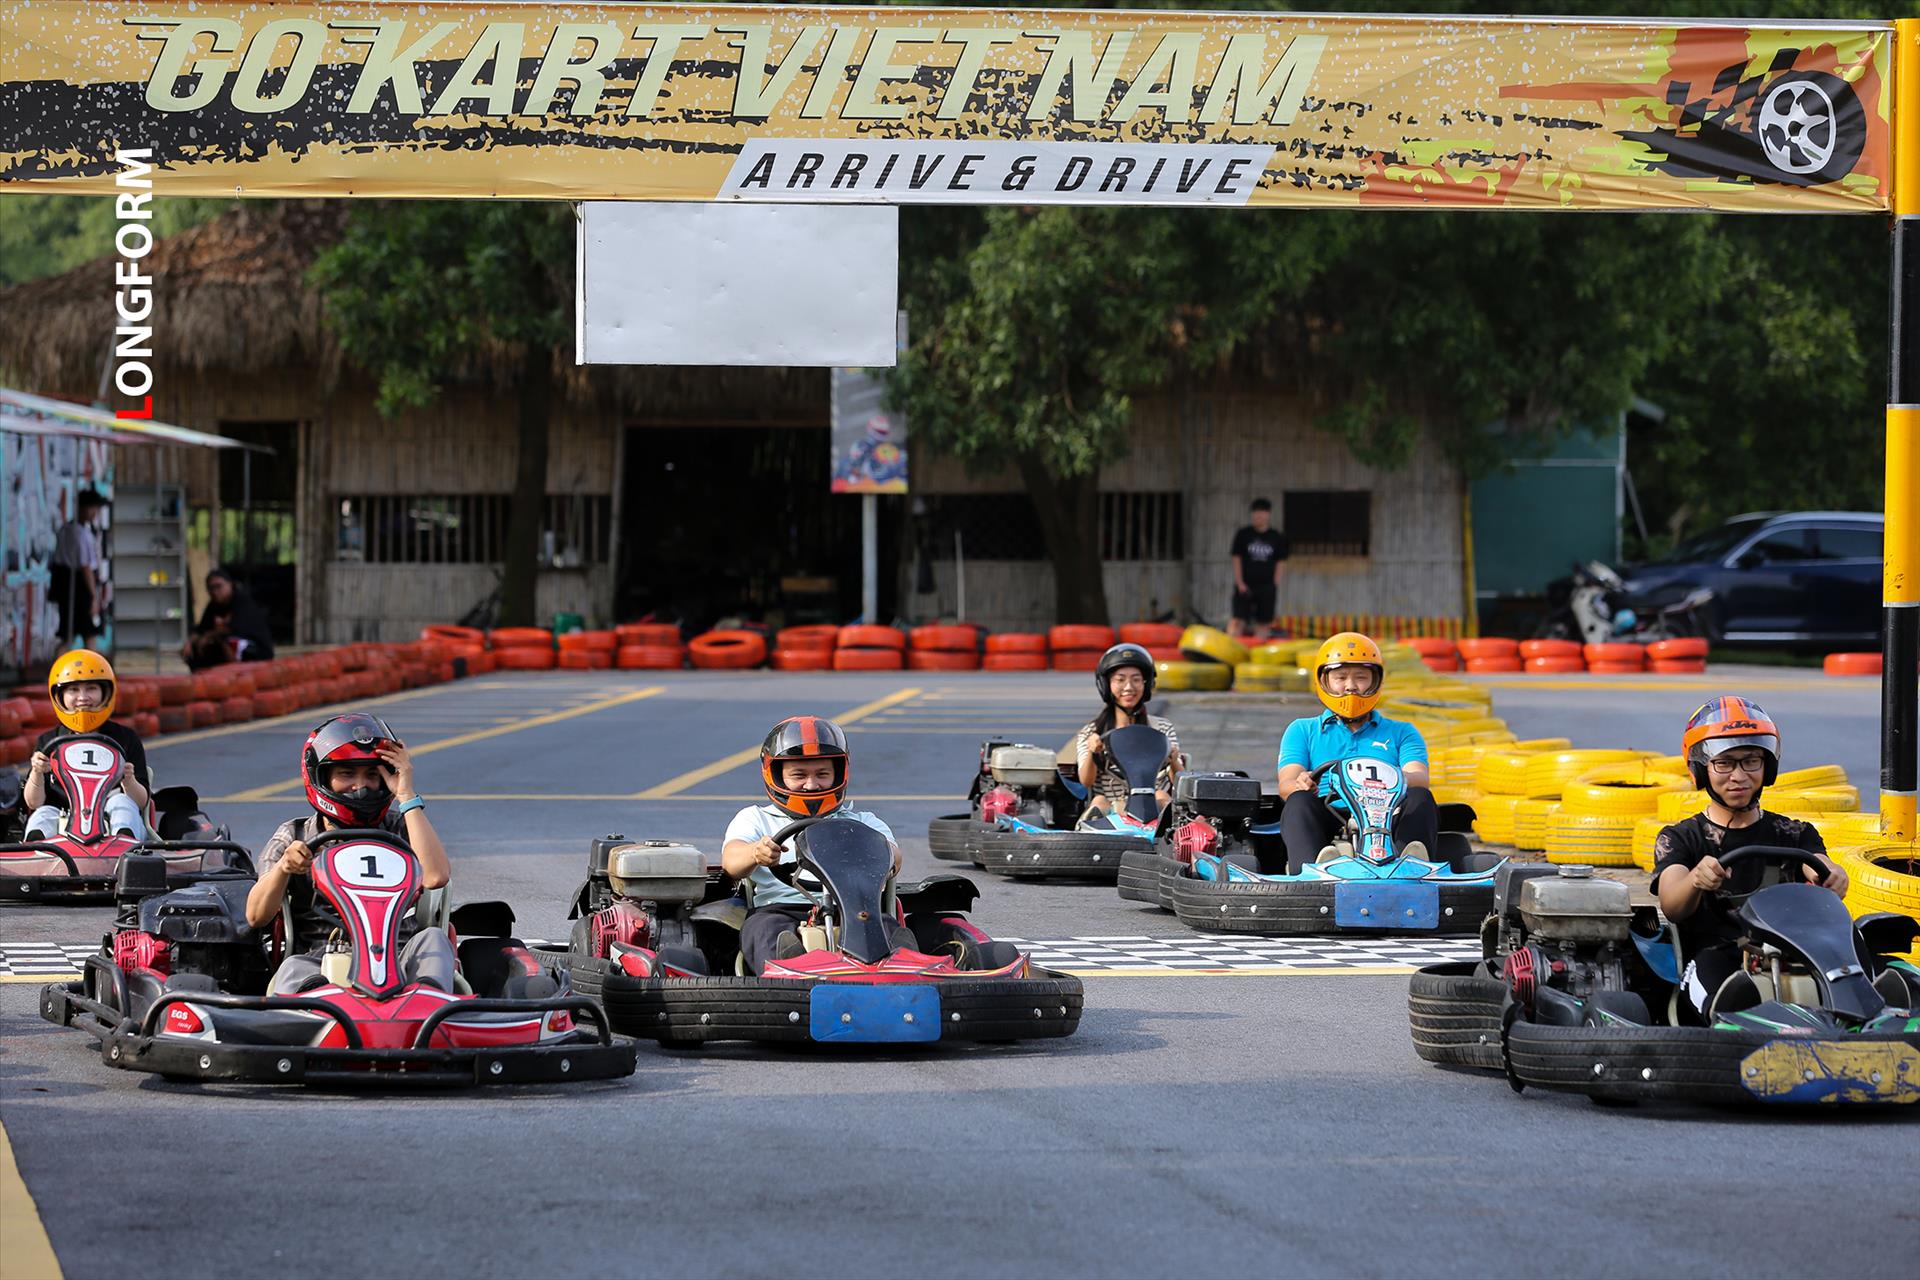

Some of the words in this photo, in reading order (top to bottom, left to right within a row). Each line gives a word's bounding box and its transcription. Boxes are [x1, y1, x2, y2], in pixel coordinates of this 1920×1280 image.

[122, 17, 329, 113] GO
[327, 20, 711, 117] KART
[714, 24, 1018, 119] VIET
[1021, 29, 1329, 126] NAM
[739, 152, 986, 191] ARRIVE
[1001, 156, 1037, 191] &
[1054, 157, 1252, 194] DRIVE
[81, 750, 98, 766] 1
[360, 855, 384, 878] 1
